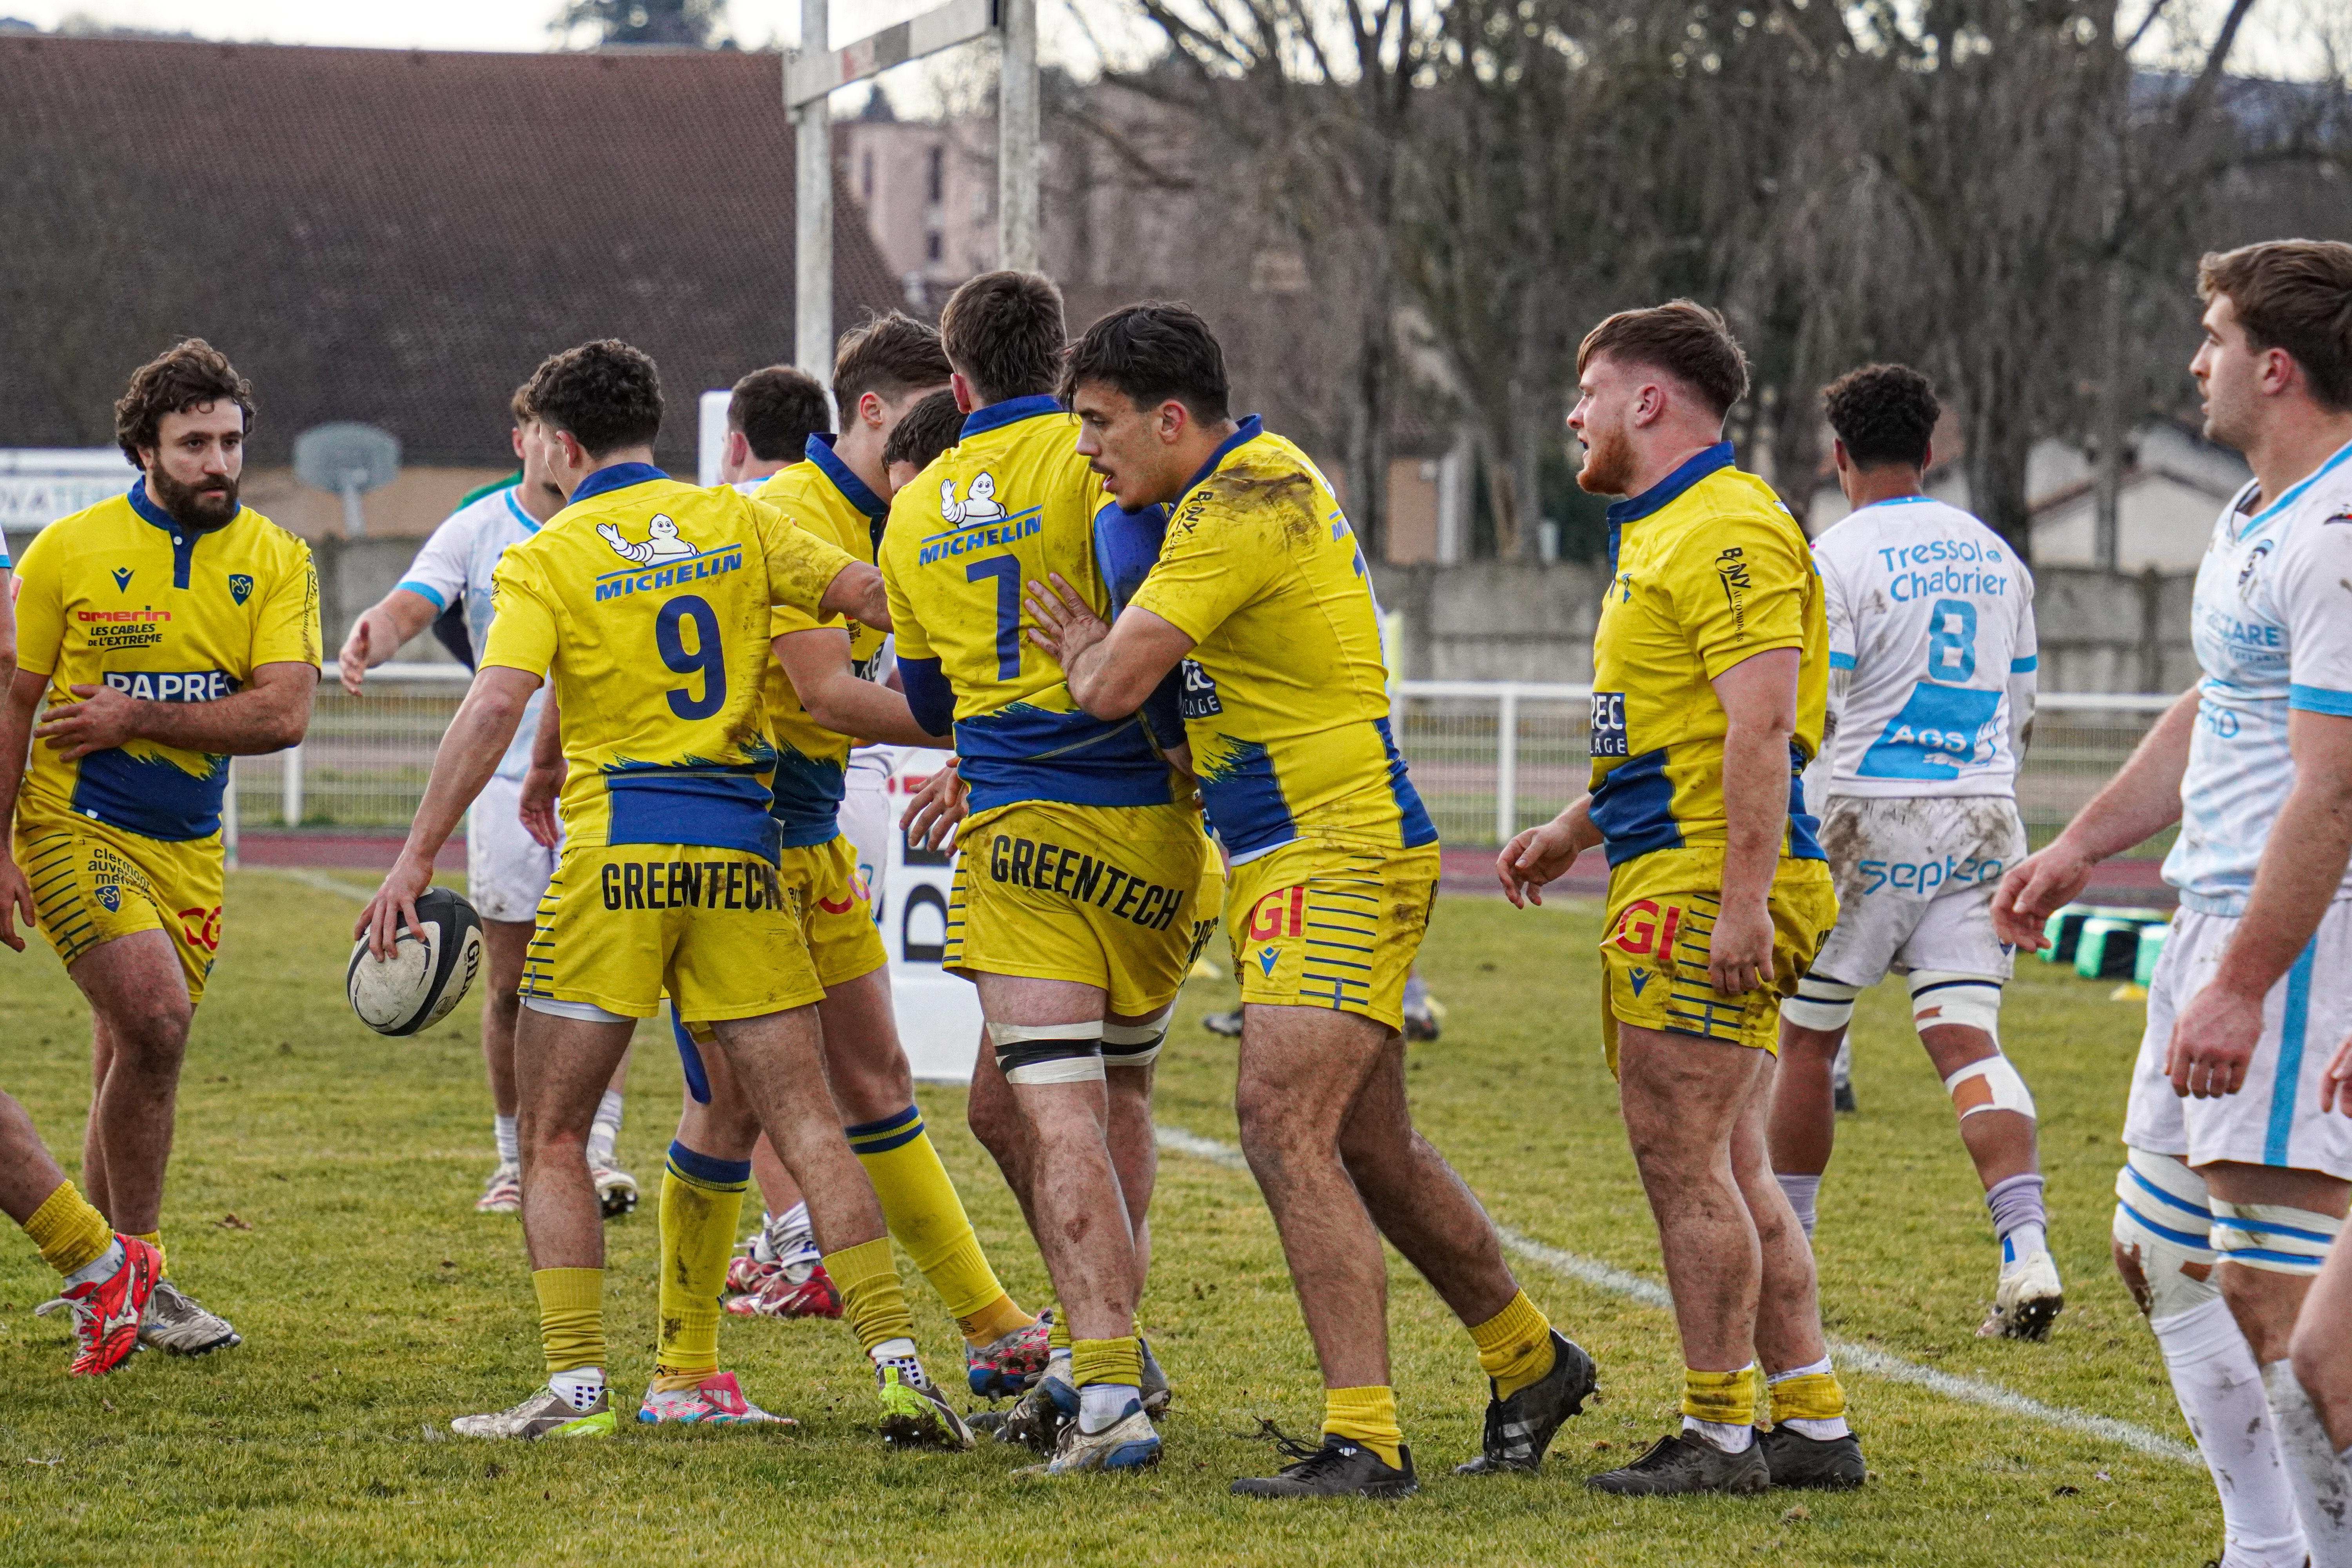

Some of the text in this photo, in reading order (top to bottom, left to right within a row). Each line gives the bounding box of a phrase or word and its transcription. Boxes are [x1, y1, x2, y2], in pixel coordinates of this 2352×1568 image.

[919, 514, 1042, 566] MICHELIN
[1878, 539, 1983, 572] Tressol
[595, 552, 742, 602] MICHELIN
[1715, 547, 1751, 588] BONY
[1890, 566, 2007, 602] Chabrier
[78, 605, 171, 622] omerin
[91, 624, 156, 636] LES CABLES
[965, 554, 1021, 682] 7
[99, 633, 163, 646] L'EXTREME
[655, 595, 727, 721] 9
[1928, 598, 1977, 682] 8
[1889, 725, 1967, 753] AGS
[602, 862, 782, 910] GREENTECH
[991, 835, 1184, 931] GREENTECH
[1859, 855, 2002, 895] septeo
[1250, 886, 1305, 941] GI
[1616, 900, 1681, 959] GI
